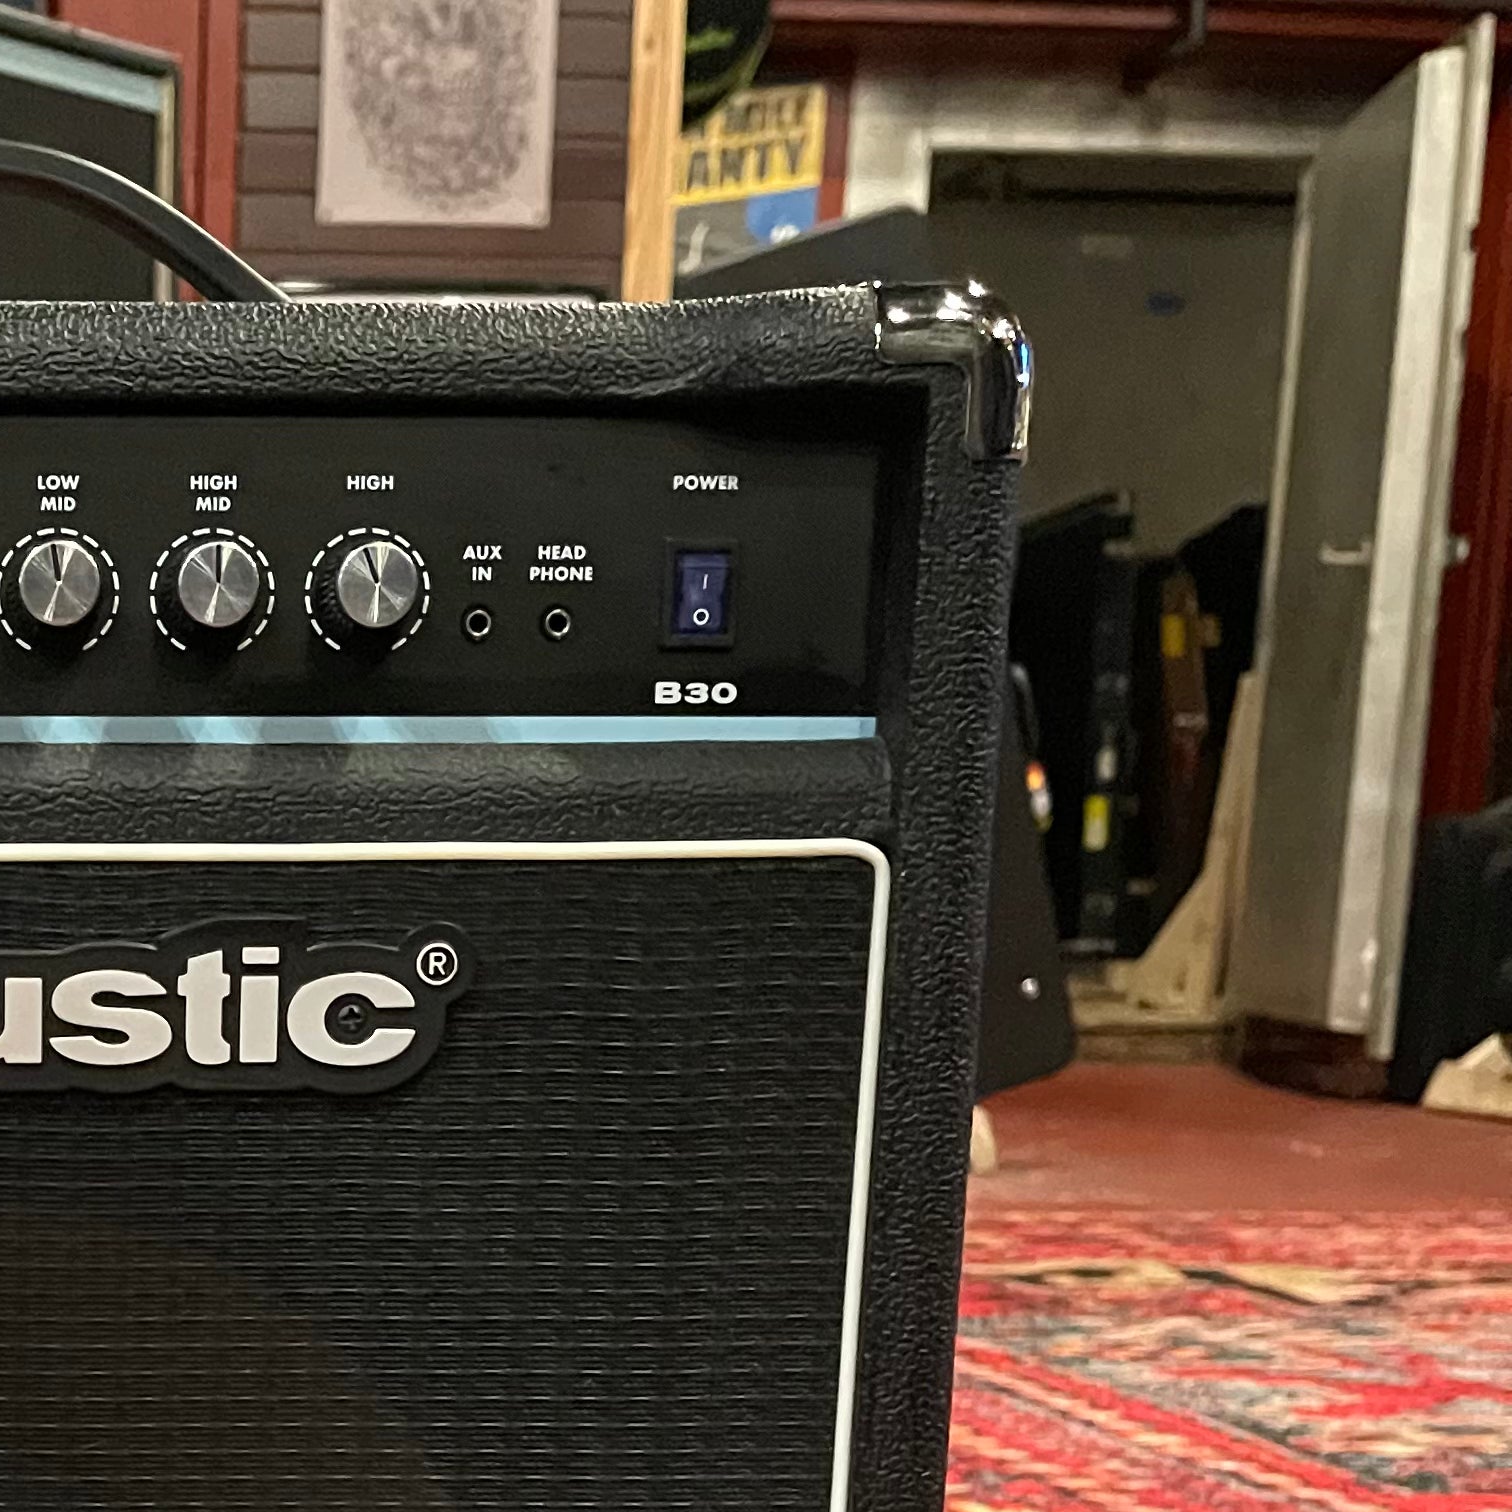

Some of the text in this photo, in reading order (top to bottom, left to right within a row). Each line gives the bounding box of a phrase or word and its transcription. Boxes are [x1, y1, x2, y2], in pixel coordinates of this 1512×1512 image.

[37, 474, 80, 490] LOW
[190, 474, 238, 490] HIGH
[347, 474, 394, 490] HIGH
[673, 474, 739, 490] POWER
[40, 496, 76, 512] MID
[195, 496, 232, 512] MID
[462, 545, 502, 560] AUX
[537, 545, 587, 560] HEAD
[472, 566, 492, 581] IN
[529, 566, 593, 582] PHONE
[654, 681, 738, 704] B30
